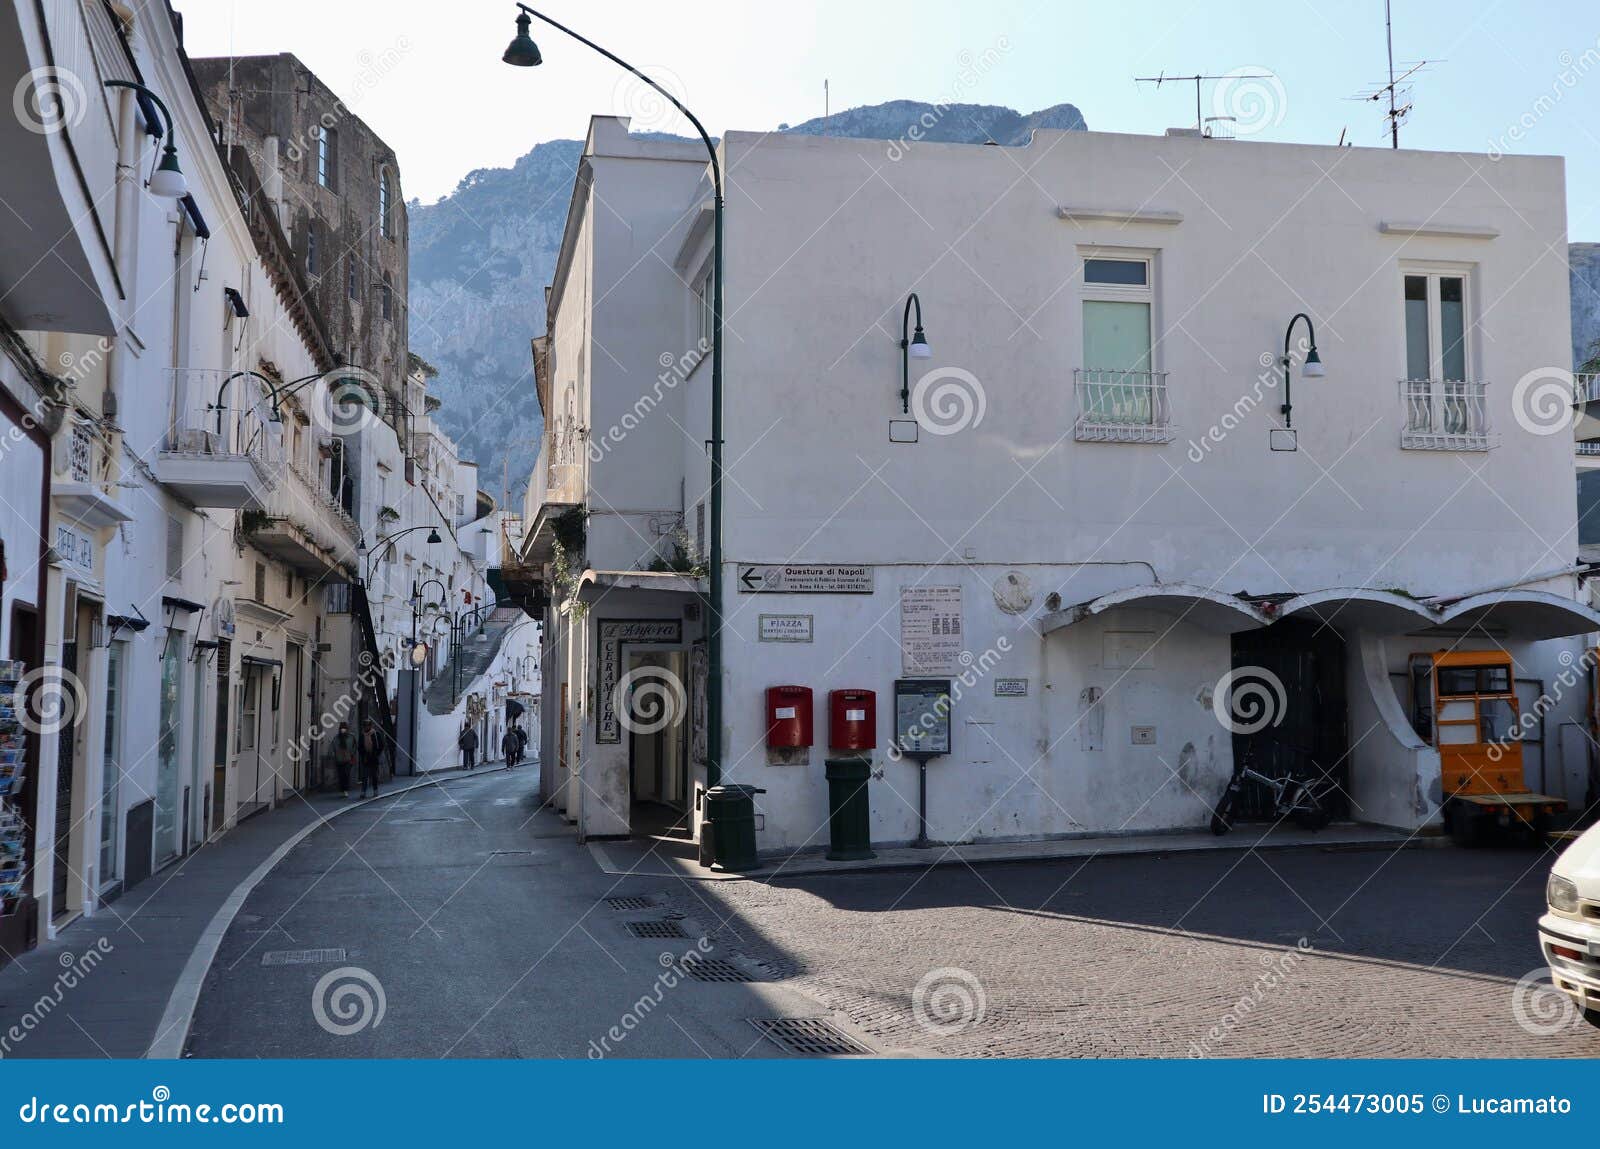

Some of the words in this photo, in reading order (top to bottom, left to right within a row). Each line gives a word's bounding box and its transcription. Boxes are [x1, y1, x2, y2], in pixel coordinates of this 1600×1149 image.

[785, 567, 823, 575] Questura
[838, 568, 865, 576] Napoli
[770, 620, 802, 628] PIAZZA
[603, 641, 615, 732] CERAMICHE
